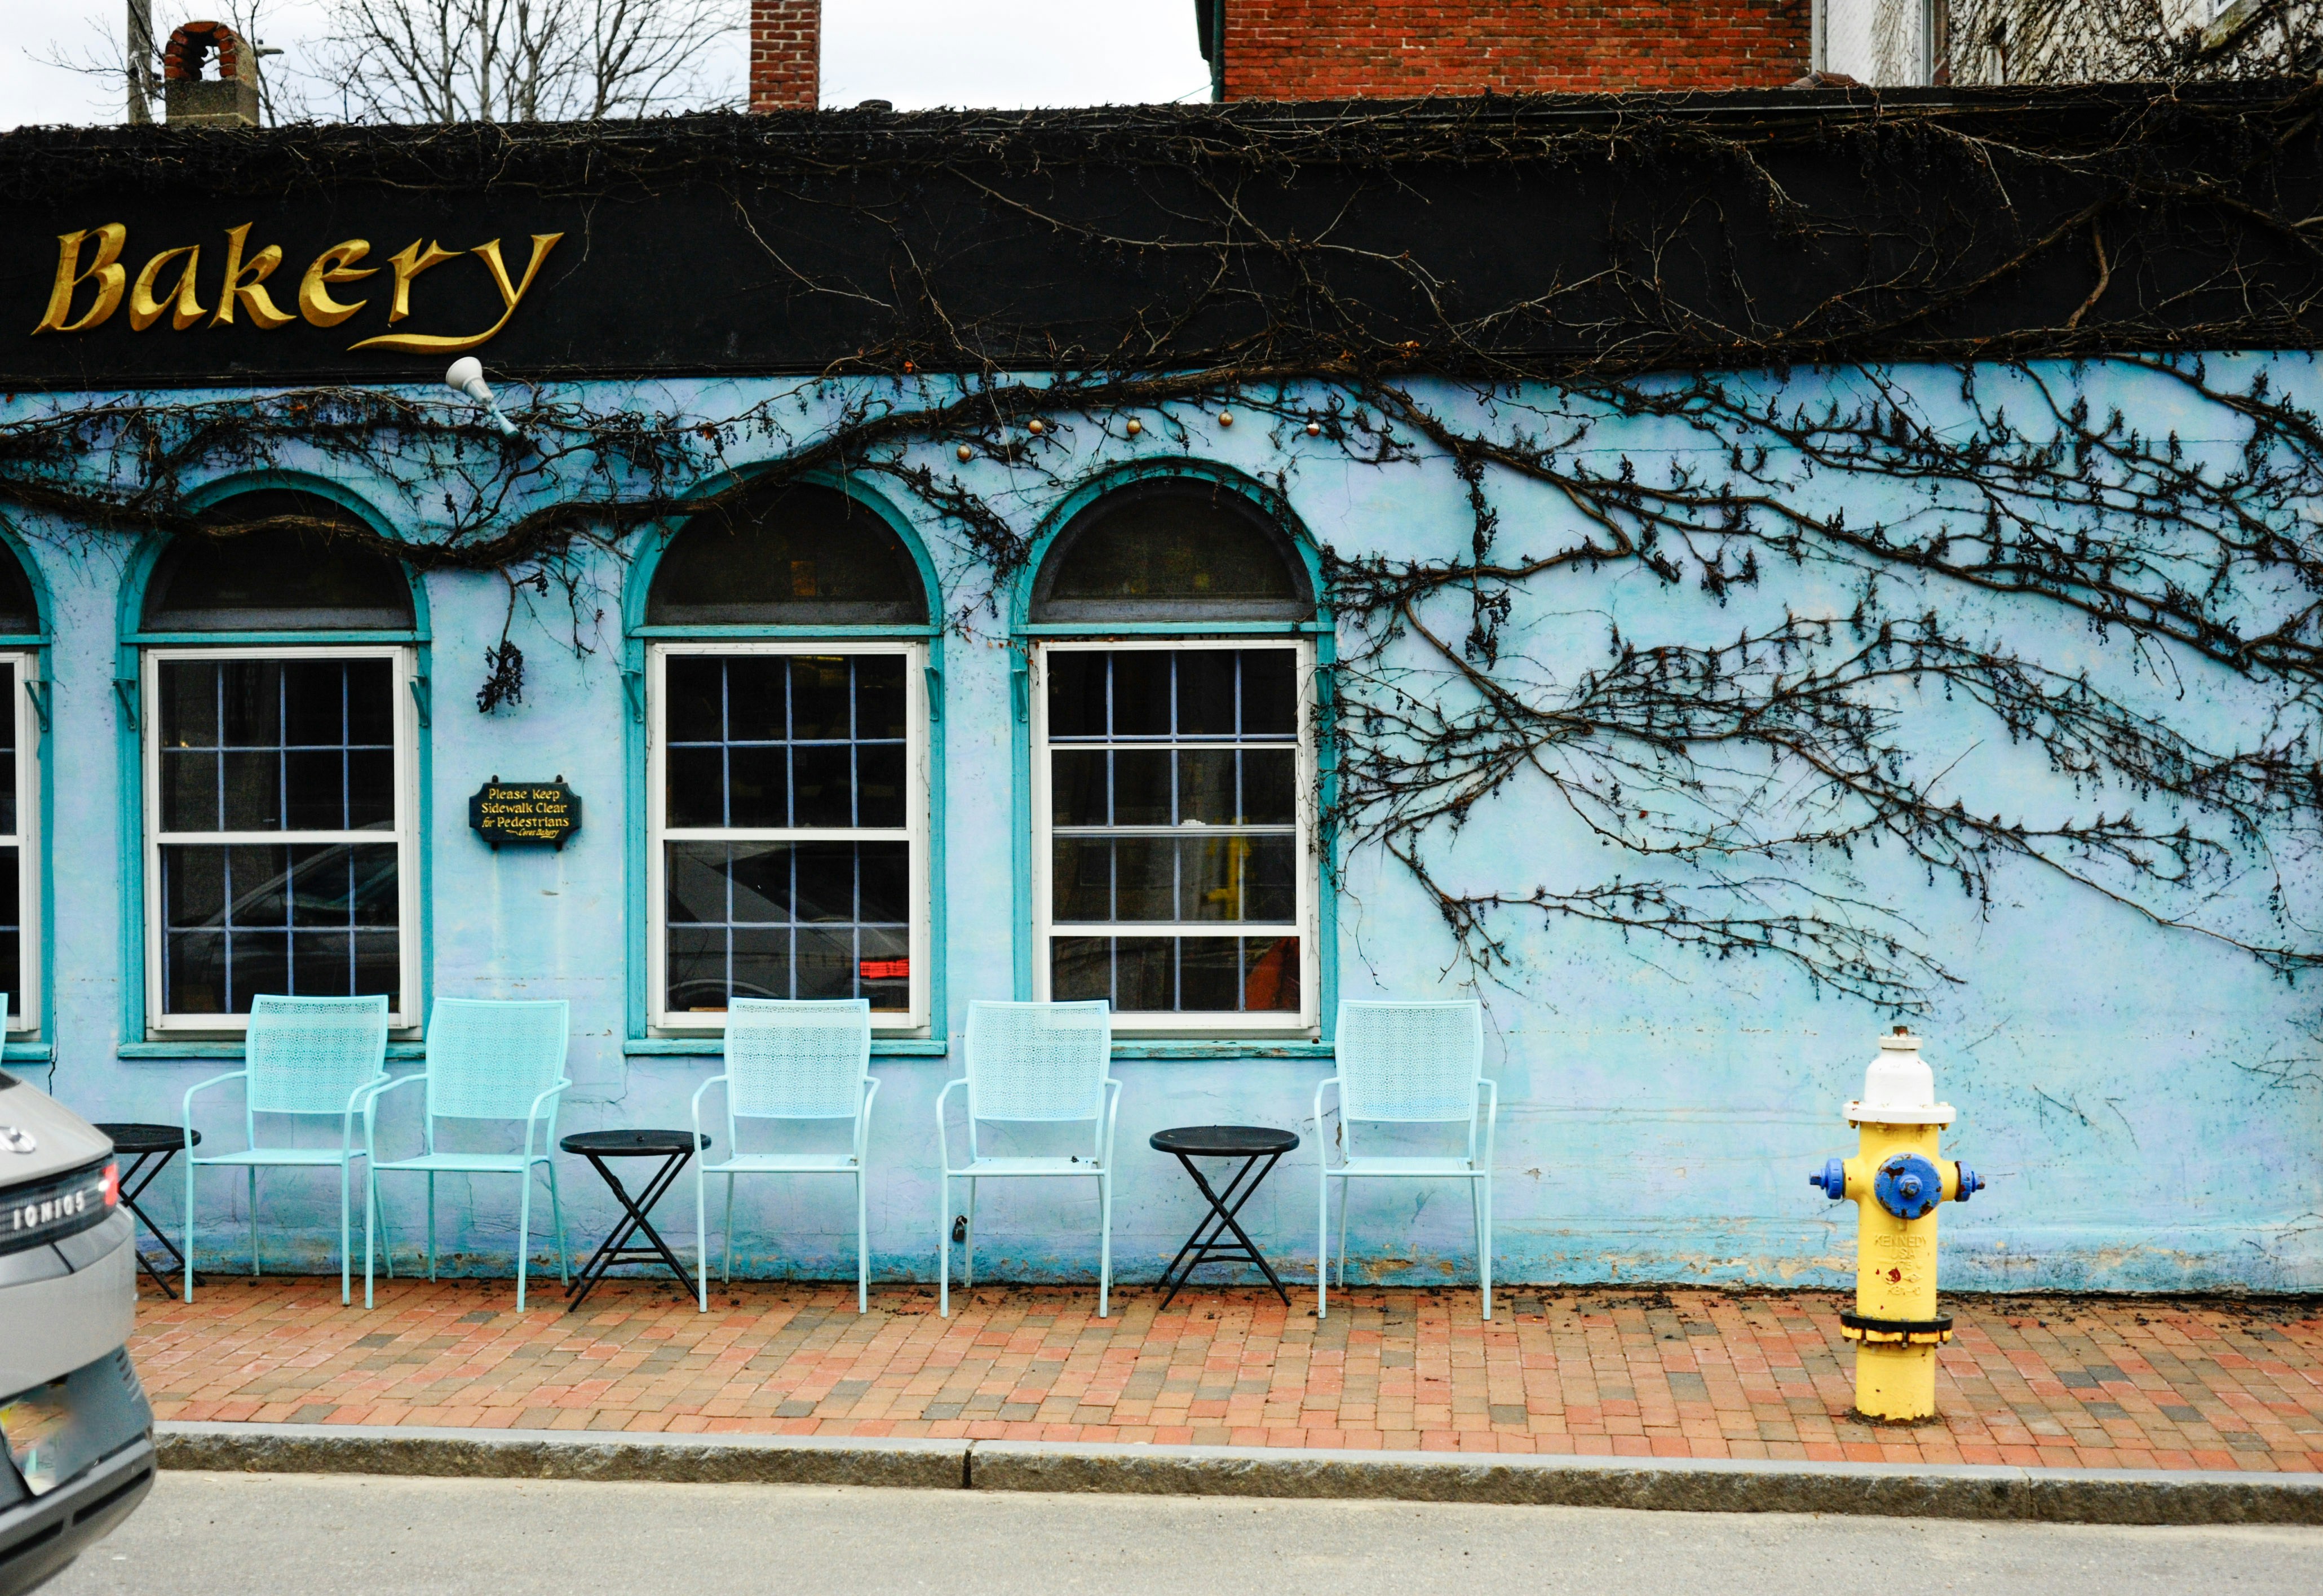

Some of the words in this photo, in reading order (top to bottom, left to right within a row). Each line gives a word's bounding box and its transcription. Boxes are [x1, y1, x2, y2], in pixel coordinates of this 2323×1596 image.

[30, 221, 565, 354] Bakery
[489, 788, 527, 799] Please
[533, 789, 560, 801] Keep
[481, 803, 533, 813] Sidewalk
[536, 803, 568, 813] Clear
[481, 817, 495, 827] for
[497, 817, 569, 827] Pedestrians
[536, 828, 559, 839] Bakery
[1873, 1234, 1927, 1247] KENNEDY
[1891, 1247, 1916, 1259] USA
